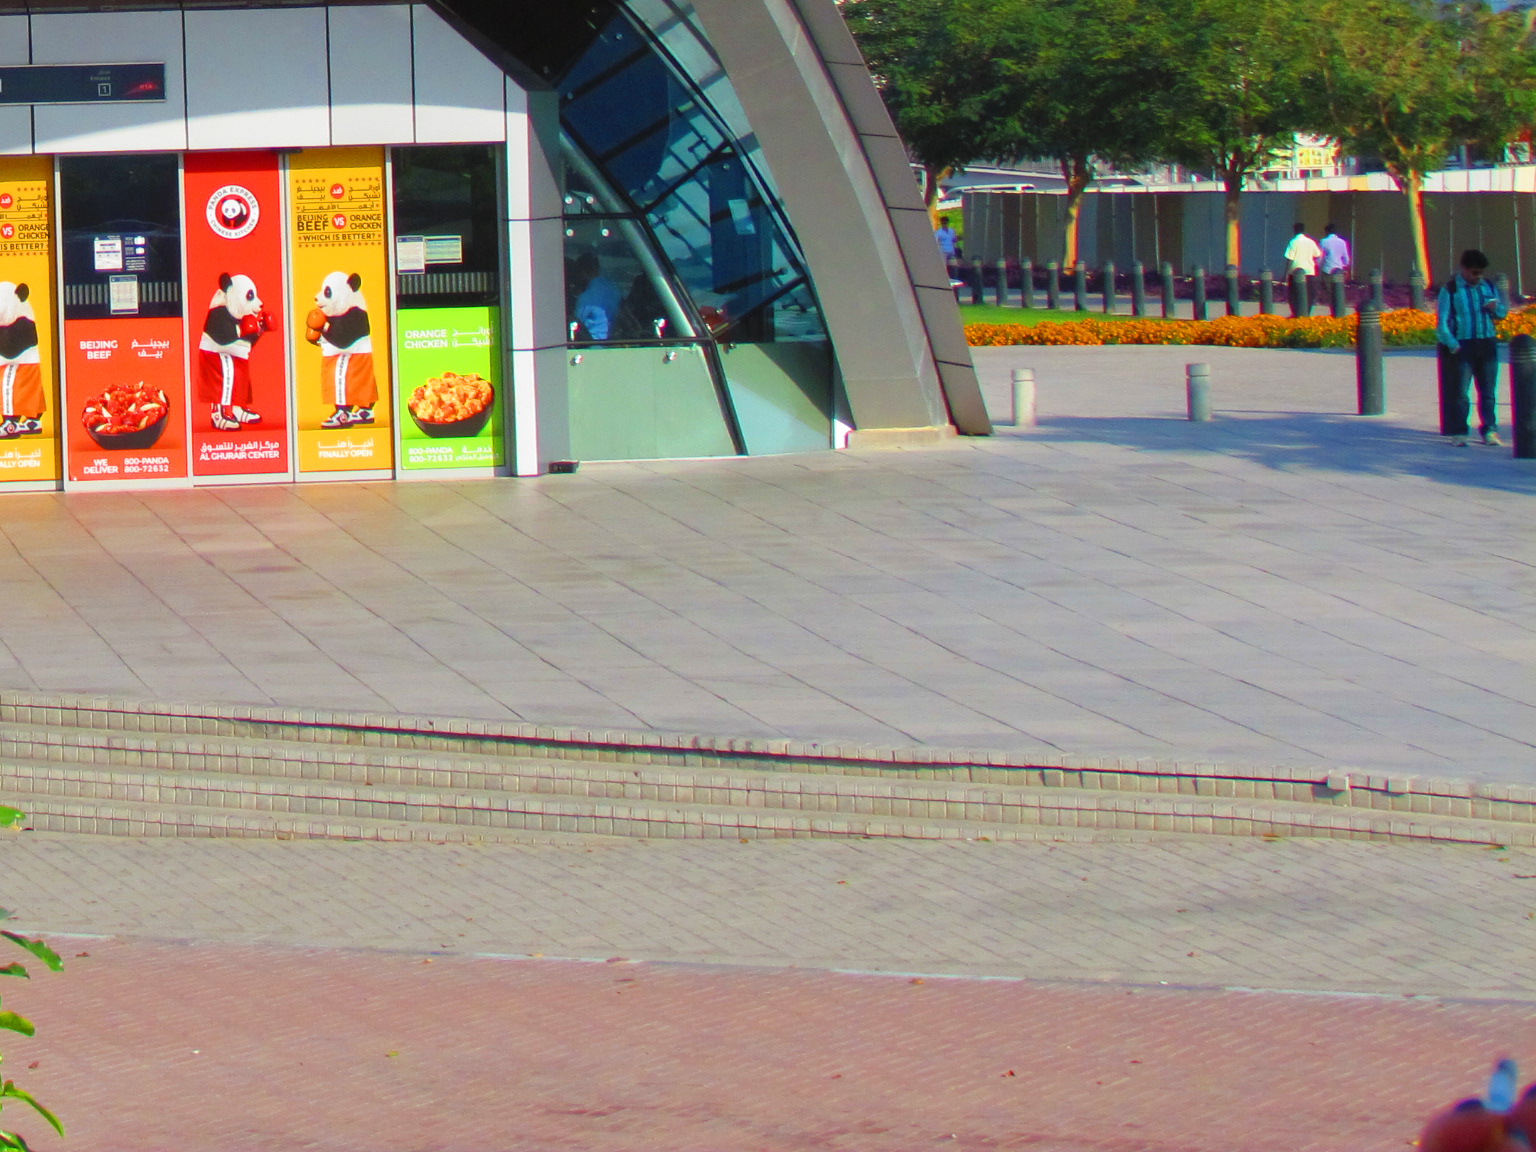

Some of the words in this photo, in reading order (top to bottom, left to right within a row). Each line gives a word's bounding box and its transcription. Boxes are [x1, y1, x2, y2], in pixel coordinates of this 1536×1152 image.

[209, 189, 228, 210] PANDA
[230, 187, 257, 208] EXPRESS
[297, 221, 329, 231] BEEF
[334, 218, 344, 226] VS
[350, 222, 381, 230] CHICKEN
[2, 227, 13, 235] VS
[211, 220, 232, 236] CHINESE
[234, 218, 256, 236] KITCHEN
[406, 329, 447, 338] ORANGE
[80, 340, 118, 349] BEIJING
[131, 339, 170, 349] بيجينغ
[404, 339, 448, 348] CHICKEN
[87, 350, 112, 360] BEEF
[138, 349, 163, 359] بيف
[200, 442, 233, 452] للتسوق
[234, 441, 258, 452] الغرير
[259, 441, 279, 450] مركز
[200, 452, 210, 460] AL
[211, 452, 247, 460] GHURAIR
[248, 450, 280, 459] CENTER
[319, 450, 349, 458] FINALLY
[408, 447, 453, 455] 800-PANDA
[124, 457, 169, 465] 800-PANDA
[409, 455, 453, 463] 800-72632
[84, 466, 119, 474] DELIVER
[124, 465, 169, 473] 800-72632
